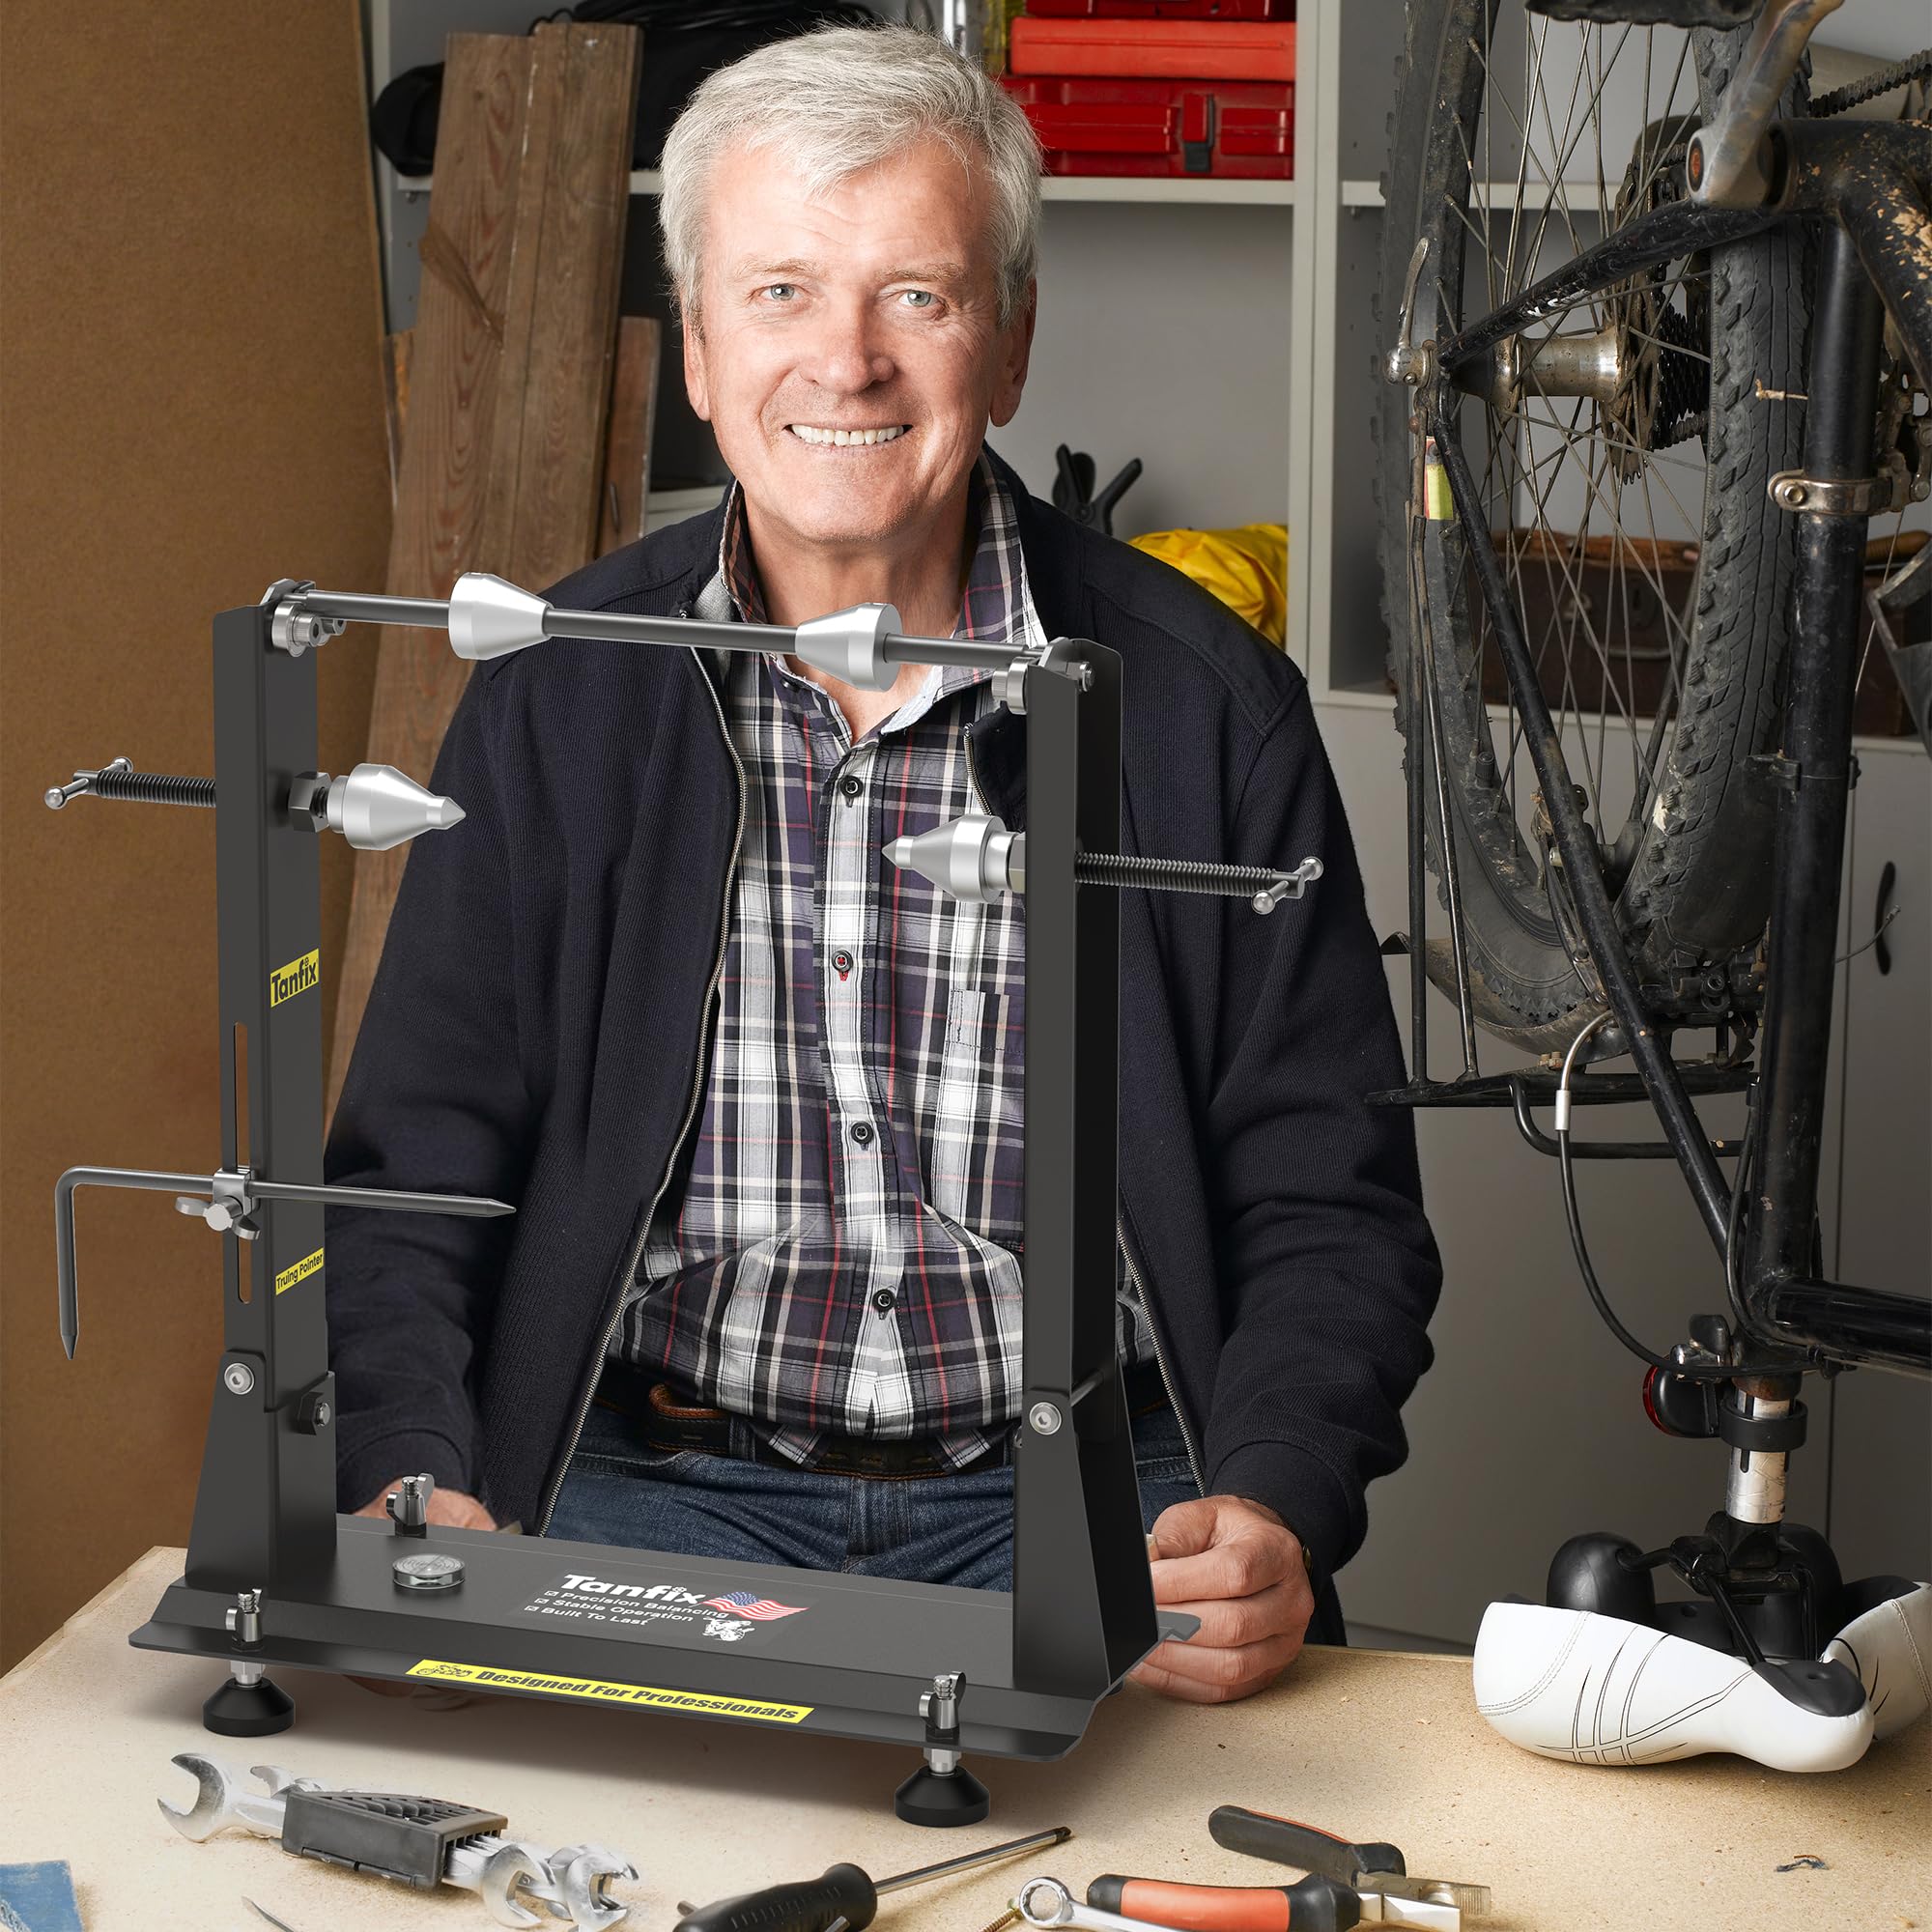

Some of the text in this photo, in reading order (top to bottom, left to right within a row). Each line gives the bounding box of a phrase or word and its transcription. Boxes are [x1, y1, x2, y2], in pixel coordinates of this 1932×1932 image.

[271, 956, 317, 1004] Tanfix
[276, 1254, 323, 1290] Truing Pointer
[561, 1574, 706, 1605] Tanfix
[541, 1607, 648, 1626] Built To Last
[553, 1600, 694, 1622] Stable Operation
[560, 1592, 729, 1619] Precision Balancing
[475, 1670, 800, 1719] Designed For Professionals
